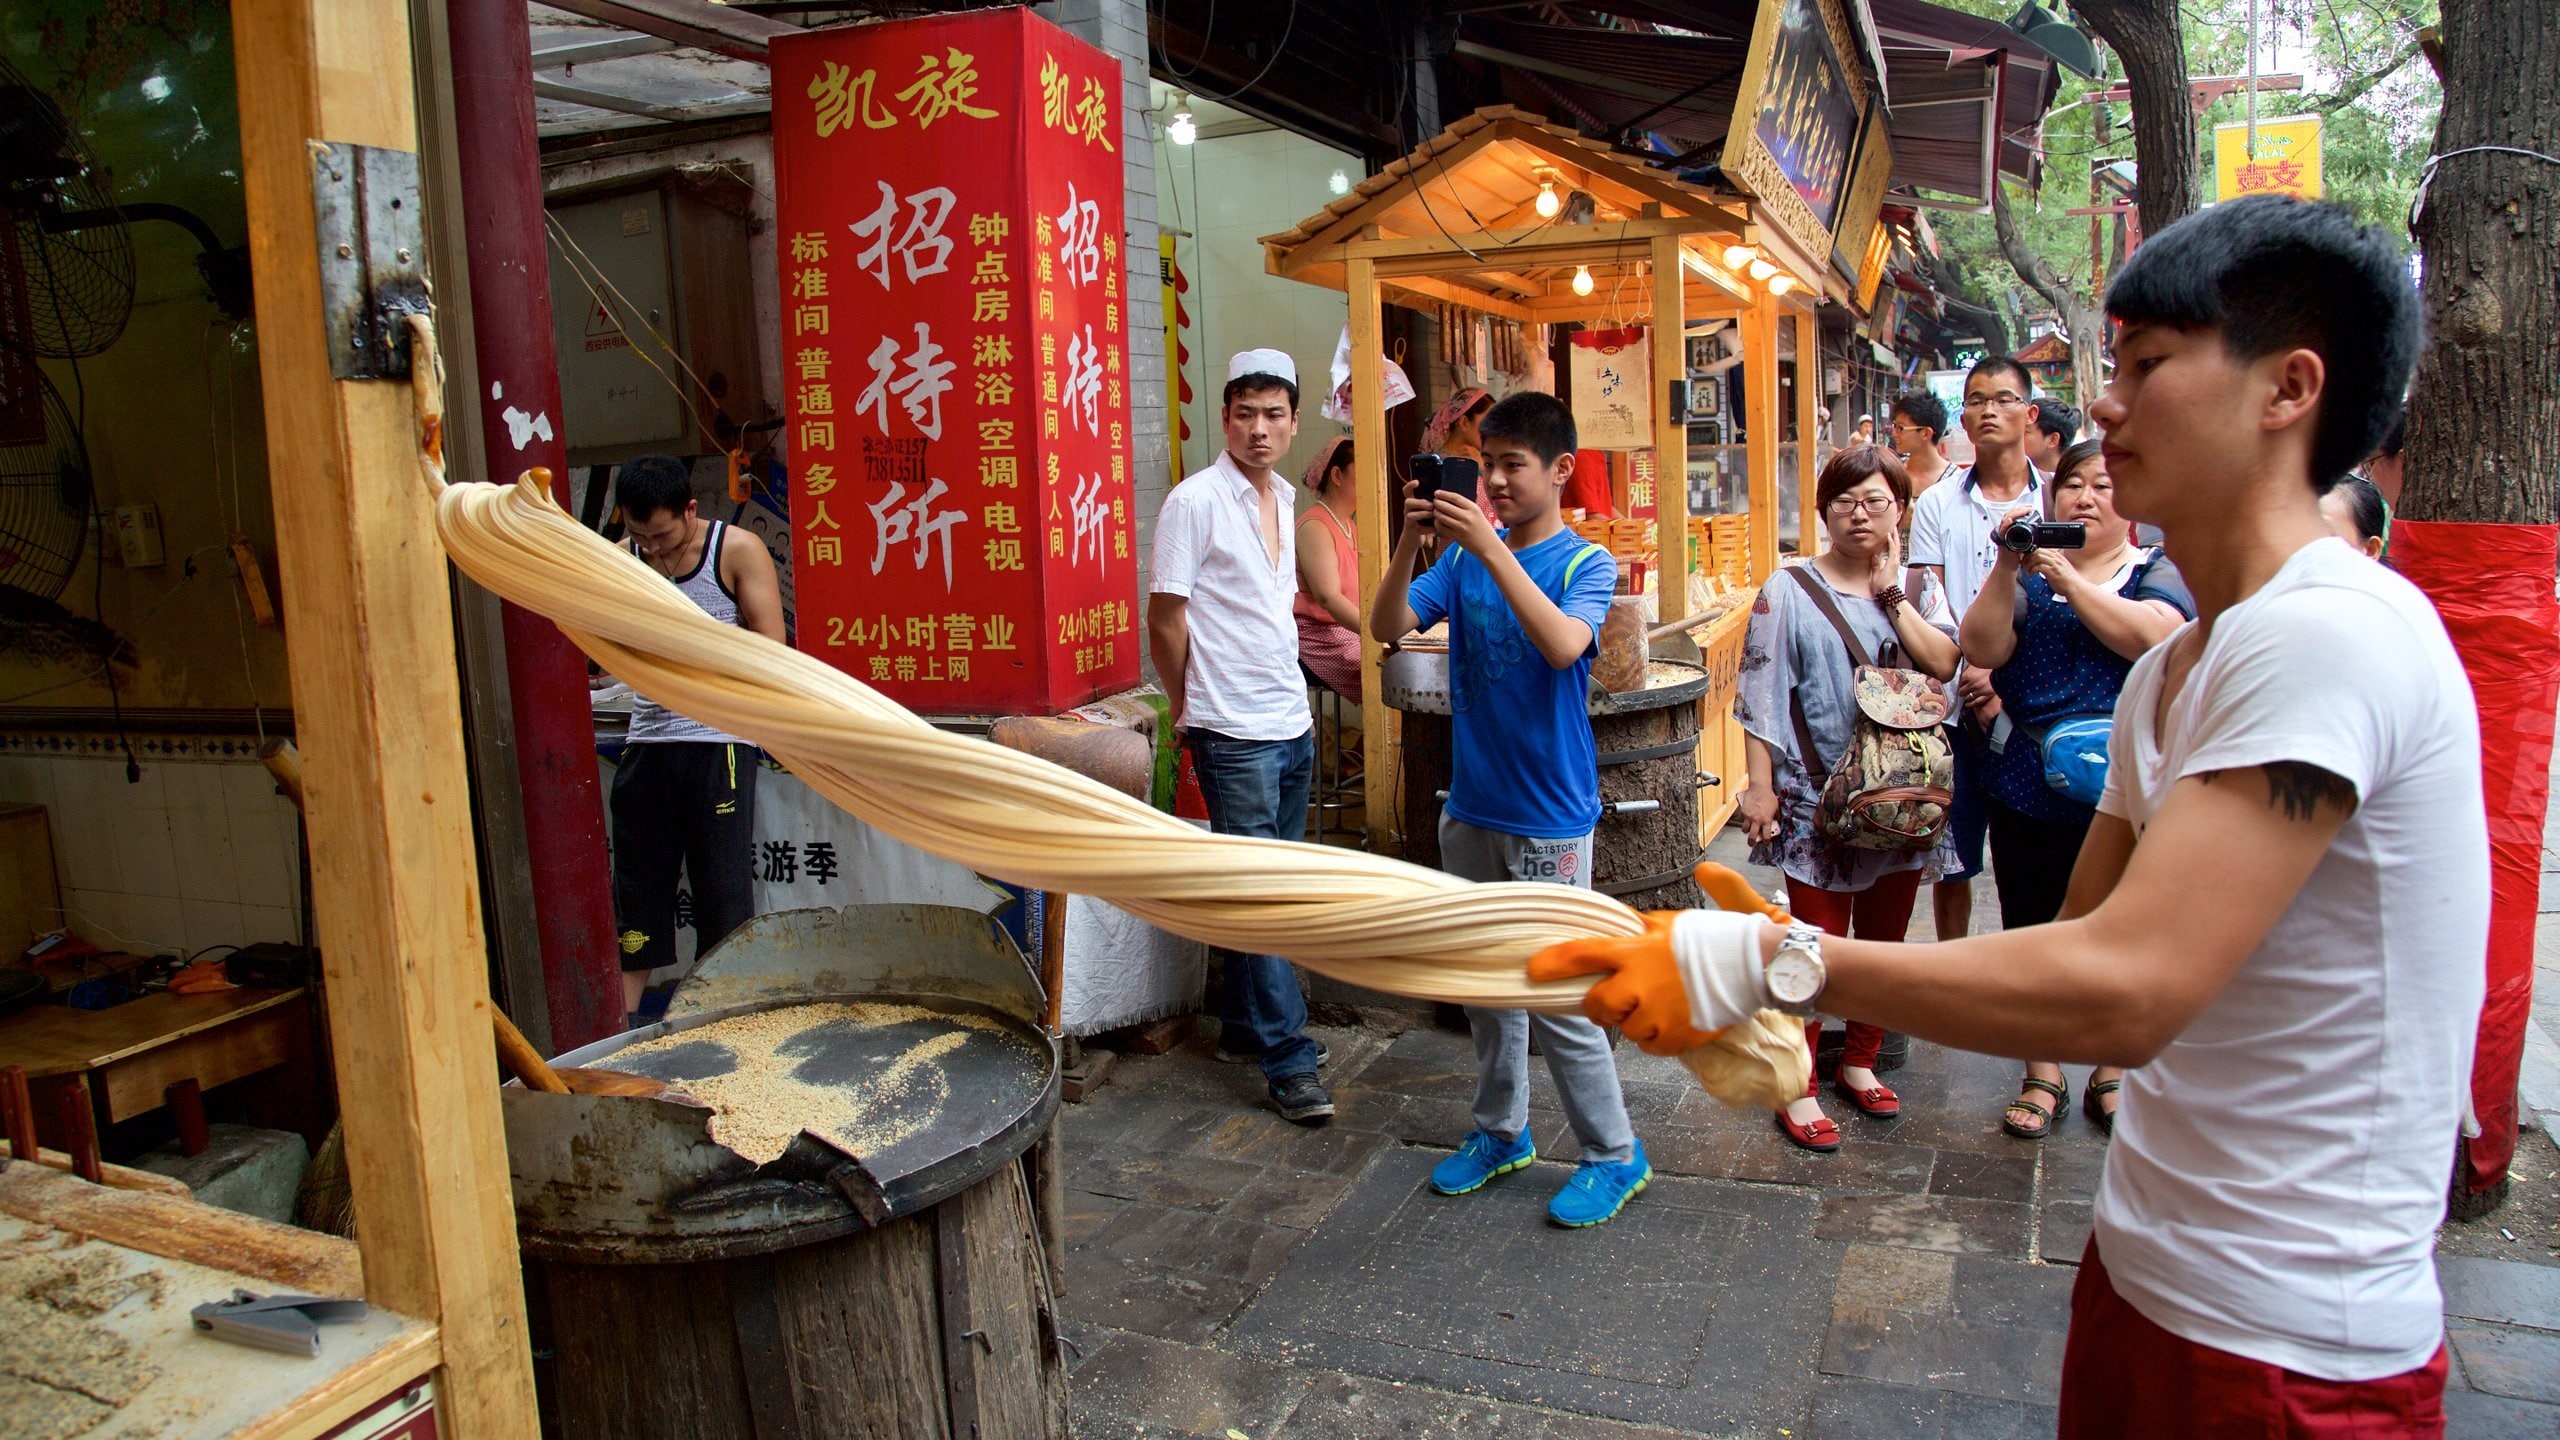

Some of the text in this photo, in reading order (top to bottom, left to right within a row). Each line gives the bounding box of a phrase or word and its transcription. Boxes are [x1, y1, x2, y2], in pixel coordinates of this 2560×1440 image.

[807, 47, 999, 138] 凯旋
[1040, 51, 1115, 153] 凯旋
[2253, 147, 2286, 160] ALAL
[791, 232, 843, 566] 标准间 普通间 多人间
[848, 179, 968, 595] 招待所
[969, 212, 1025, 571] 钟点房 淋浴 空调 电视
[1036, 212, 1065, 559] 标准间 普通间 多人间
[1056, 180, 1109, 583] 招待所
[1103, 232, 1129, 560] 钟点房 淋浴 空调 电视
[827, 613, 1016, 652] 24小时营业
[868, 656, 970, 683] 宽带上网
[1058, 600, 1130, 646] 24小时营业
[1075, 642, 1114, 675] 宽带上网
[751, 838, 839, 886] 游季
